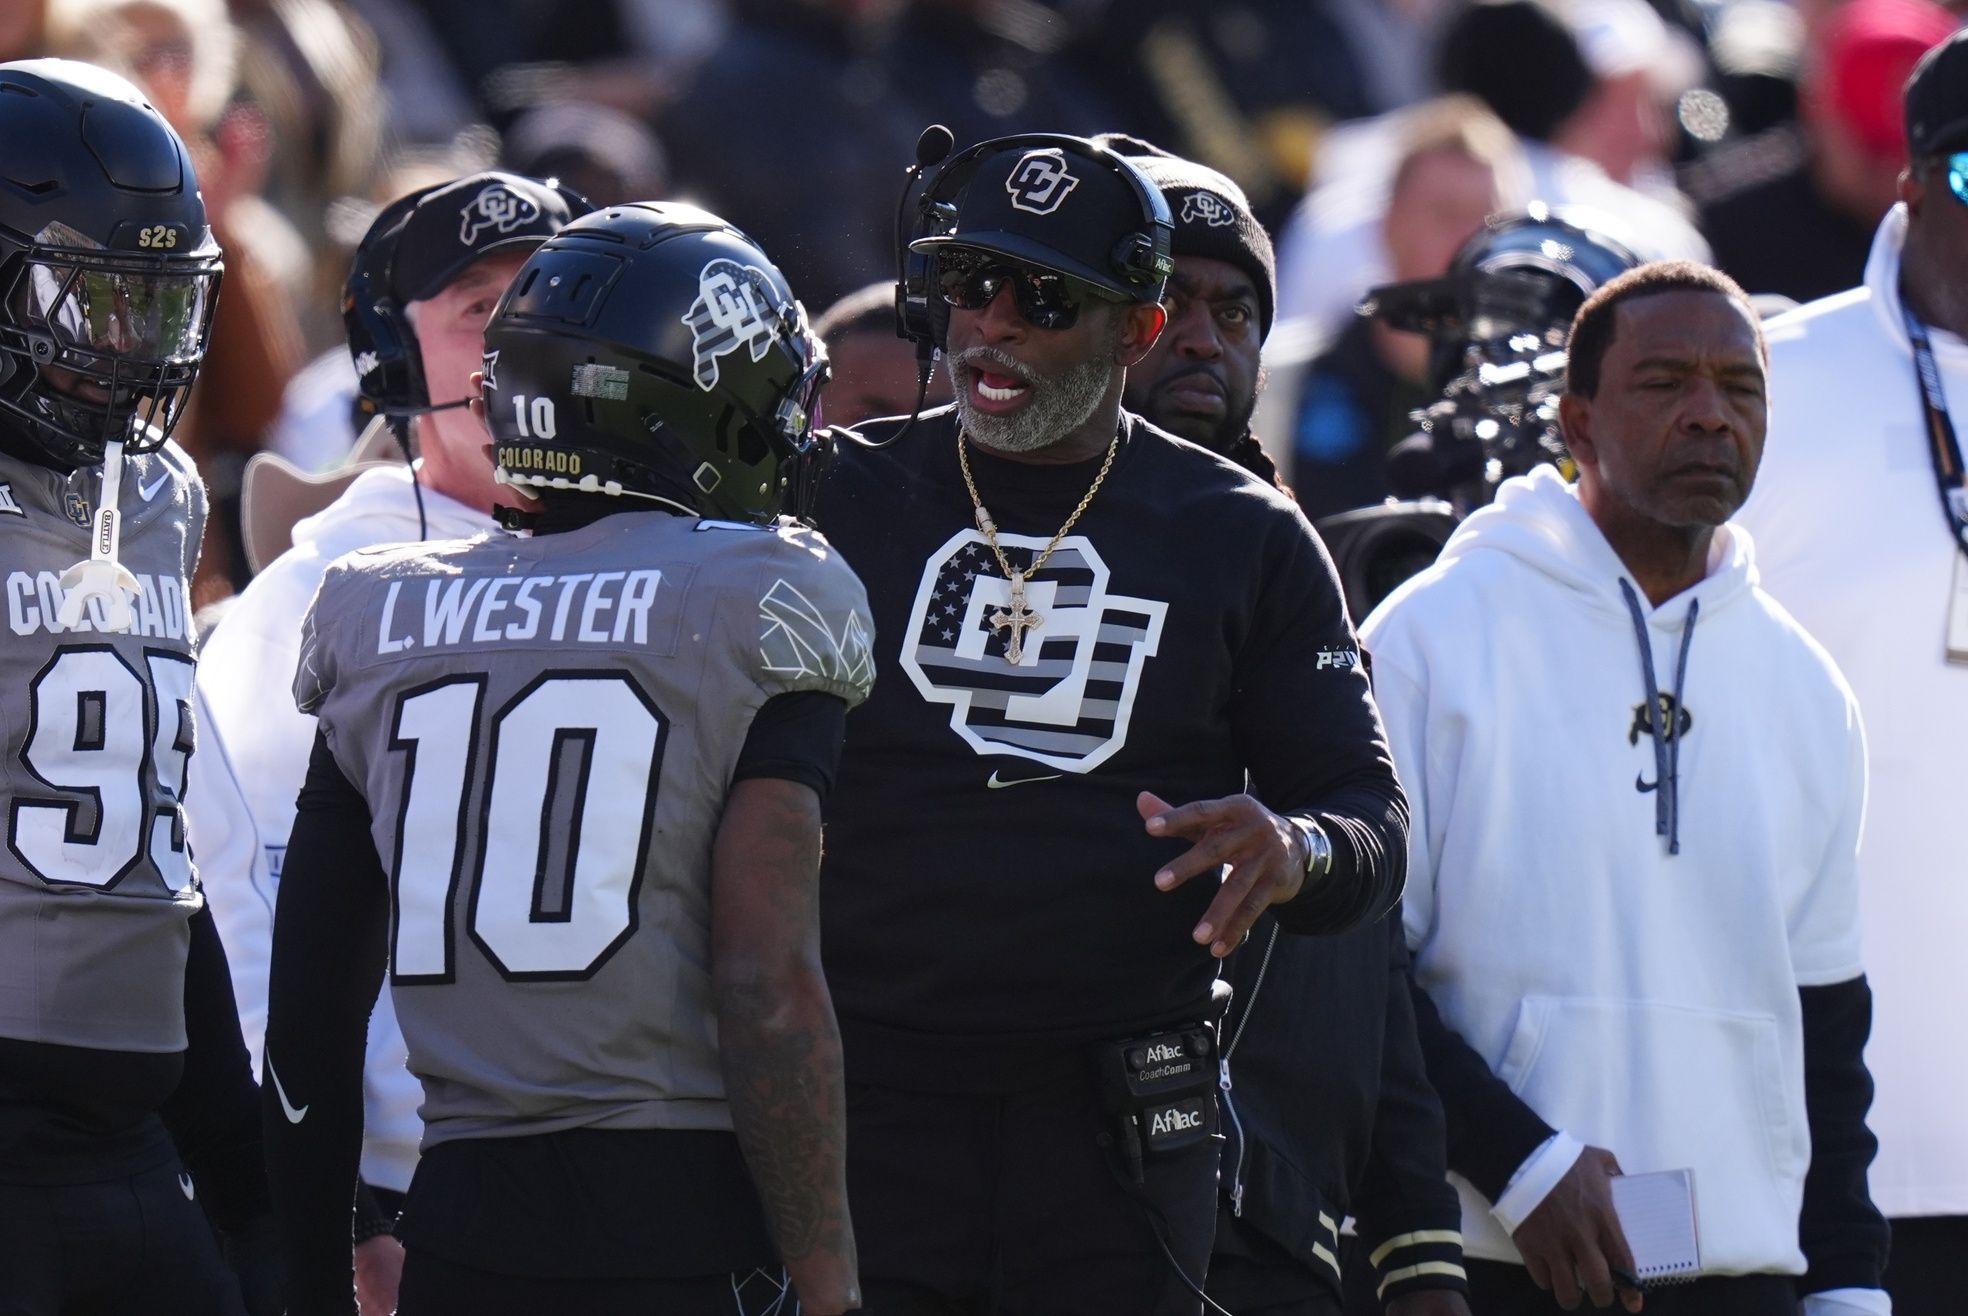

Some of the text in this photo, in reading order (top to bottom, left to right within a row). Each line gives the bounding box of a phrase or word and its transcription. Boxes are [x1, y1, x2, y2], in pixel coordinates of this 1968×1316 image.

[512, 394, 557, 440] 10
[498, 447, 581, 475] COLORADO
[101, 513, 112, 552] BATTLE
[387, 668, 671, 987] 10
[1146, 1044, 1183, 1064] Aflac
[1140, 1063, 1191, 1081] CoachComm
[1151, 1108, 1203, 1136] Aflac
